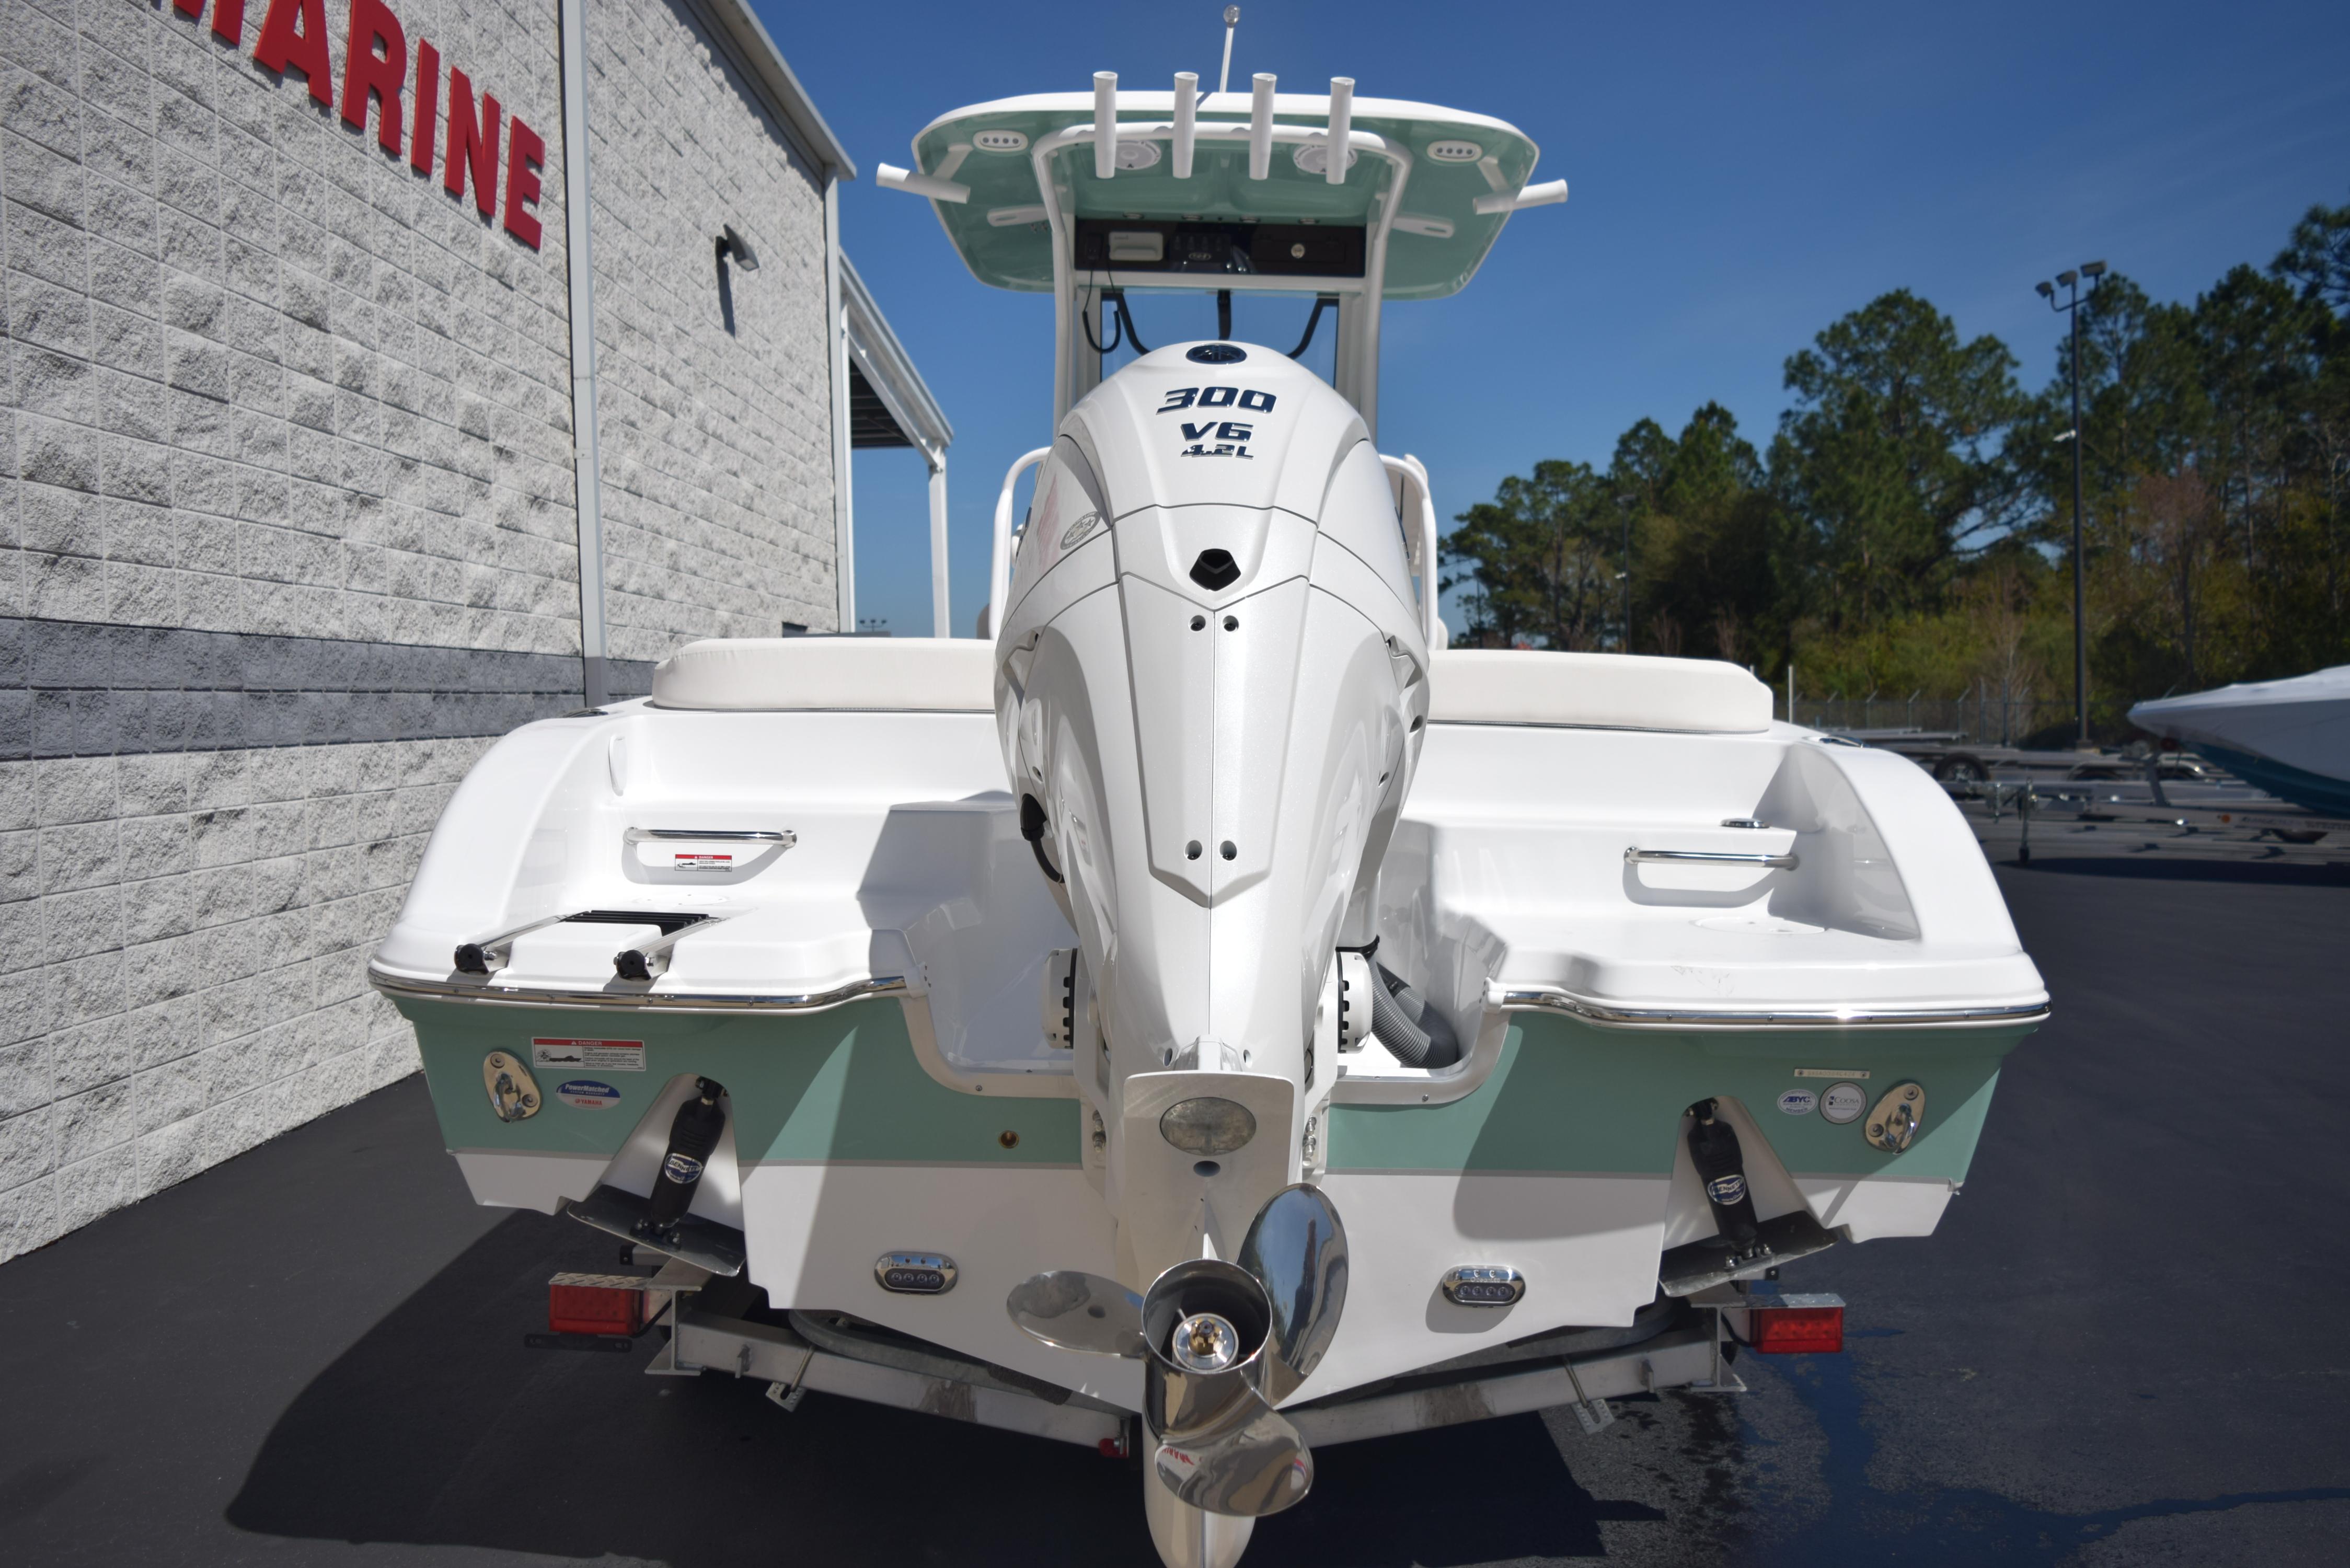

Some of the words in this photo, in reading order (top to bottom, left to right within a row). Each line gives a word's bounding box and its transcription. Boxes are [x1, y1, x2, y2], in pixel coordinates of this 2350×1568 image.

[1155, 386, 1277, 416] 300
[1180, 422, 1253, 442] V6
[1180, 444, 1254, 460] 4.2L
[565, 1083, 610, 1093] PowerMatched
